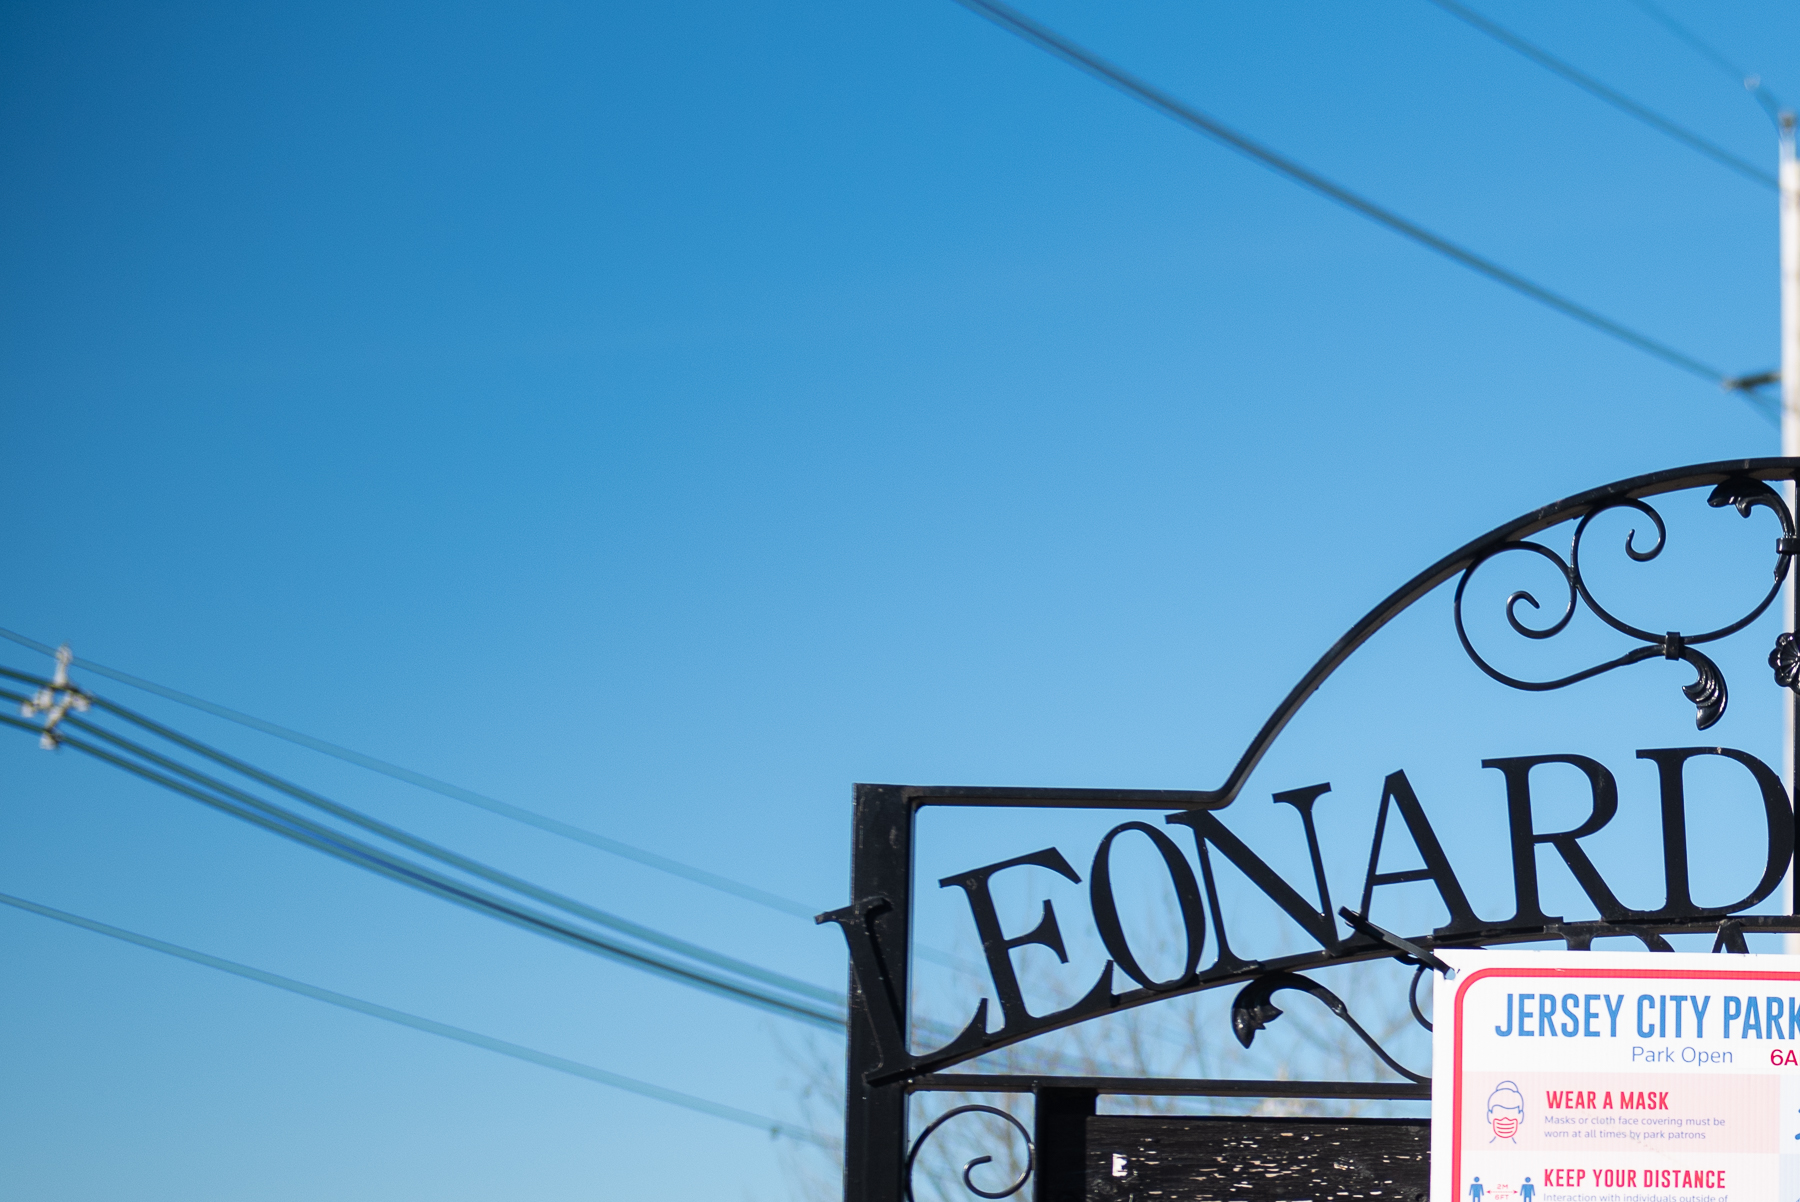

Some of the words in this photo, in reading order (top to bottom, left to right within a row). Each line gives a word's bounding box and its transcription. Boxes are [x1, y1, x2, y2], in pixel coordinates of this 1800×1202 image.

[816, 746, 1795, 1085] LEONARD
[1495, 992, 1625, 1038] JERSEY
[1636, 994, 1711, 1039] CITY
[1632, 1046, 1675, 1062] Park
[1681, 1046, 1733, 1067] Open
[1546, 1090, 1597, 1109] WEAR
[1602, 1091, 1613, 1109] A
[1620, 1091, 1669, 1110] MASK
[1544, 1115, 1576, 1124] Masks
[1590, 1115, 1616, 1124] cloth
[1618, 1116, 1639, 1125] face
[1641, 1116, 1683, 1127] covering
[1713, 1117, 1726, 1126] be
[1584, 1129, 1597, 1138] all
[1599, 1129, 1627, 1138] times
[1629, 1130, 1641, 1140] by
[1643, 1130, 1665, 1140] park
[1668, 1131, 1706, 1140] patrons
[1544, 1168, 1586, 1187] KEEP
[1592, 1169, 1637, 1187] YOUR
[1644, 1169, 1726, 1188] DISTANCE
[1543, 1193, 1597, 1202] Interaction
[1599, 1193, 1621, 1202] with
[1623, 1193, 1677, 1202] individuals
[1679, 1194, 1716, 1202] outside
[1718, 1194, 1729, 1202] of
